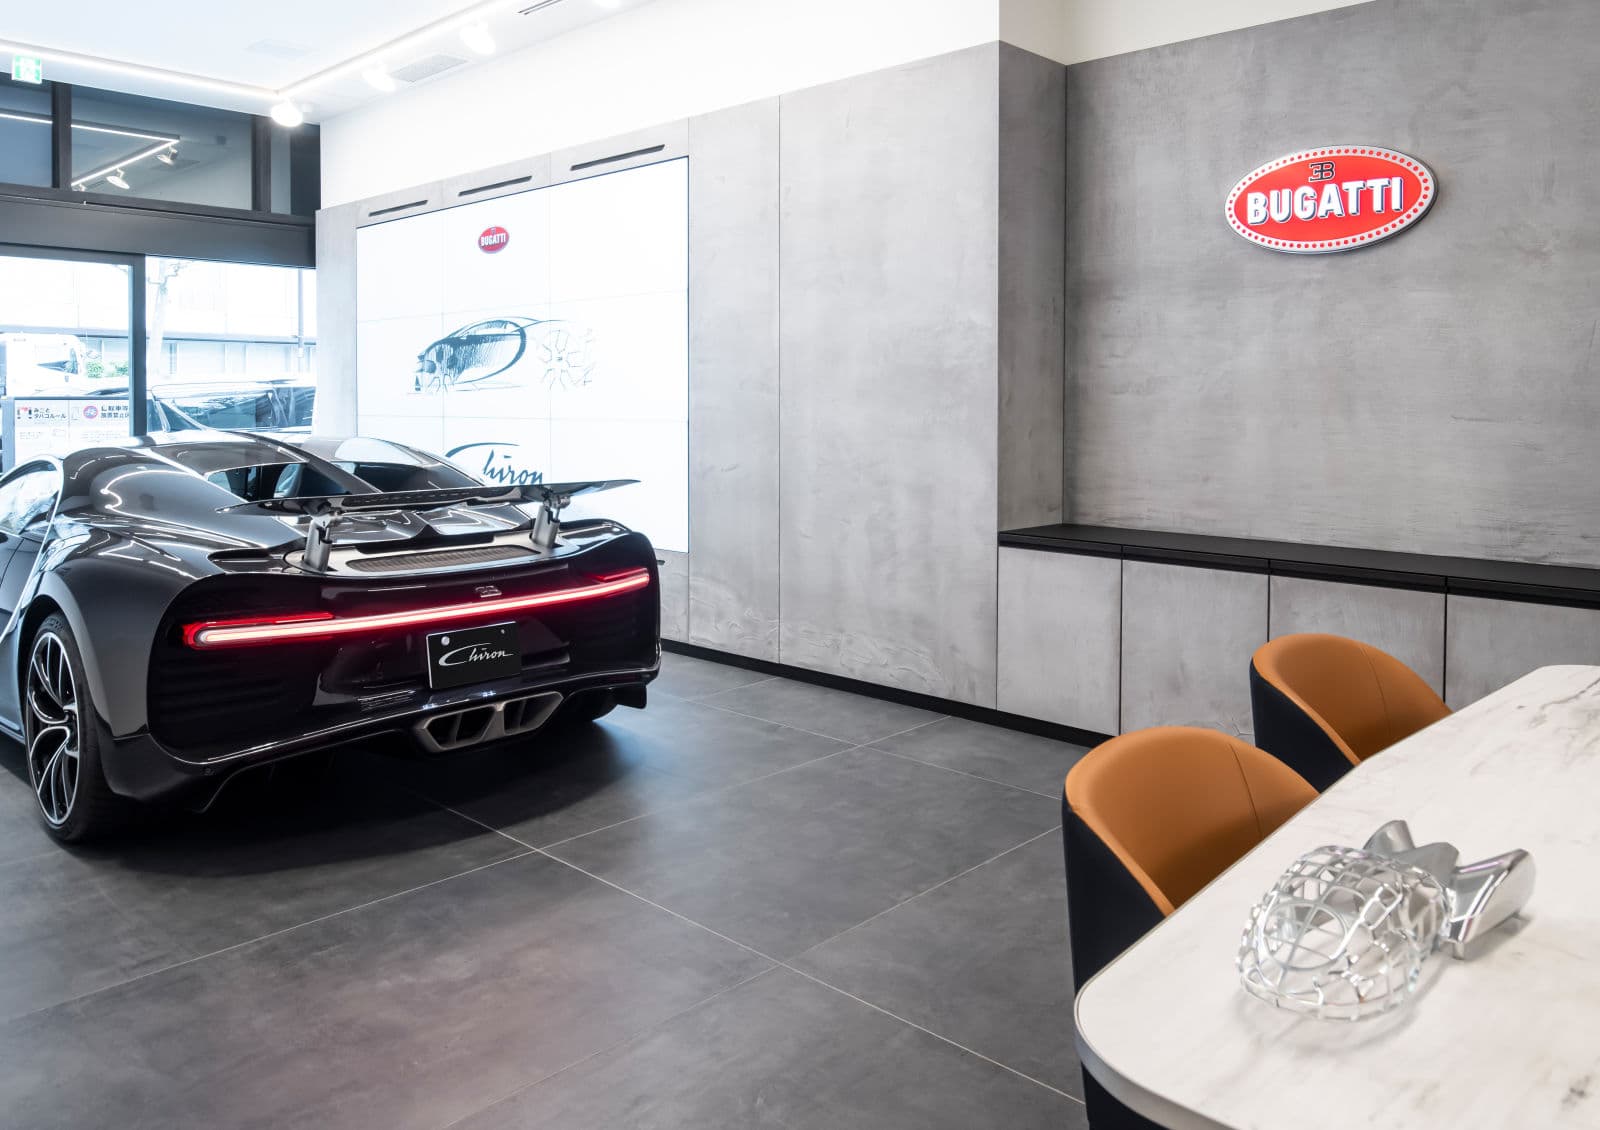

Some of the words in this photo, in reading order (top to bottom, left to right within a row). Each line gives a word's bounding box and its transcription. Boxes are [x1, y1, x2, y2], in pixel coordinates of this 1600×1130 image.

[1246, 176, 1404, 226] BUGATTI
[480, 232, 507, 247] BUGATTI
[438, 642, 514, 667] Chiron
